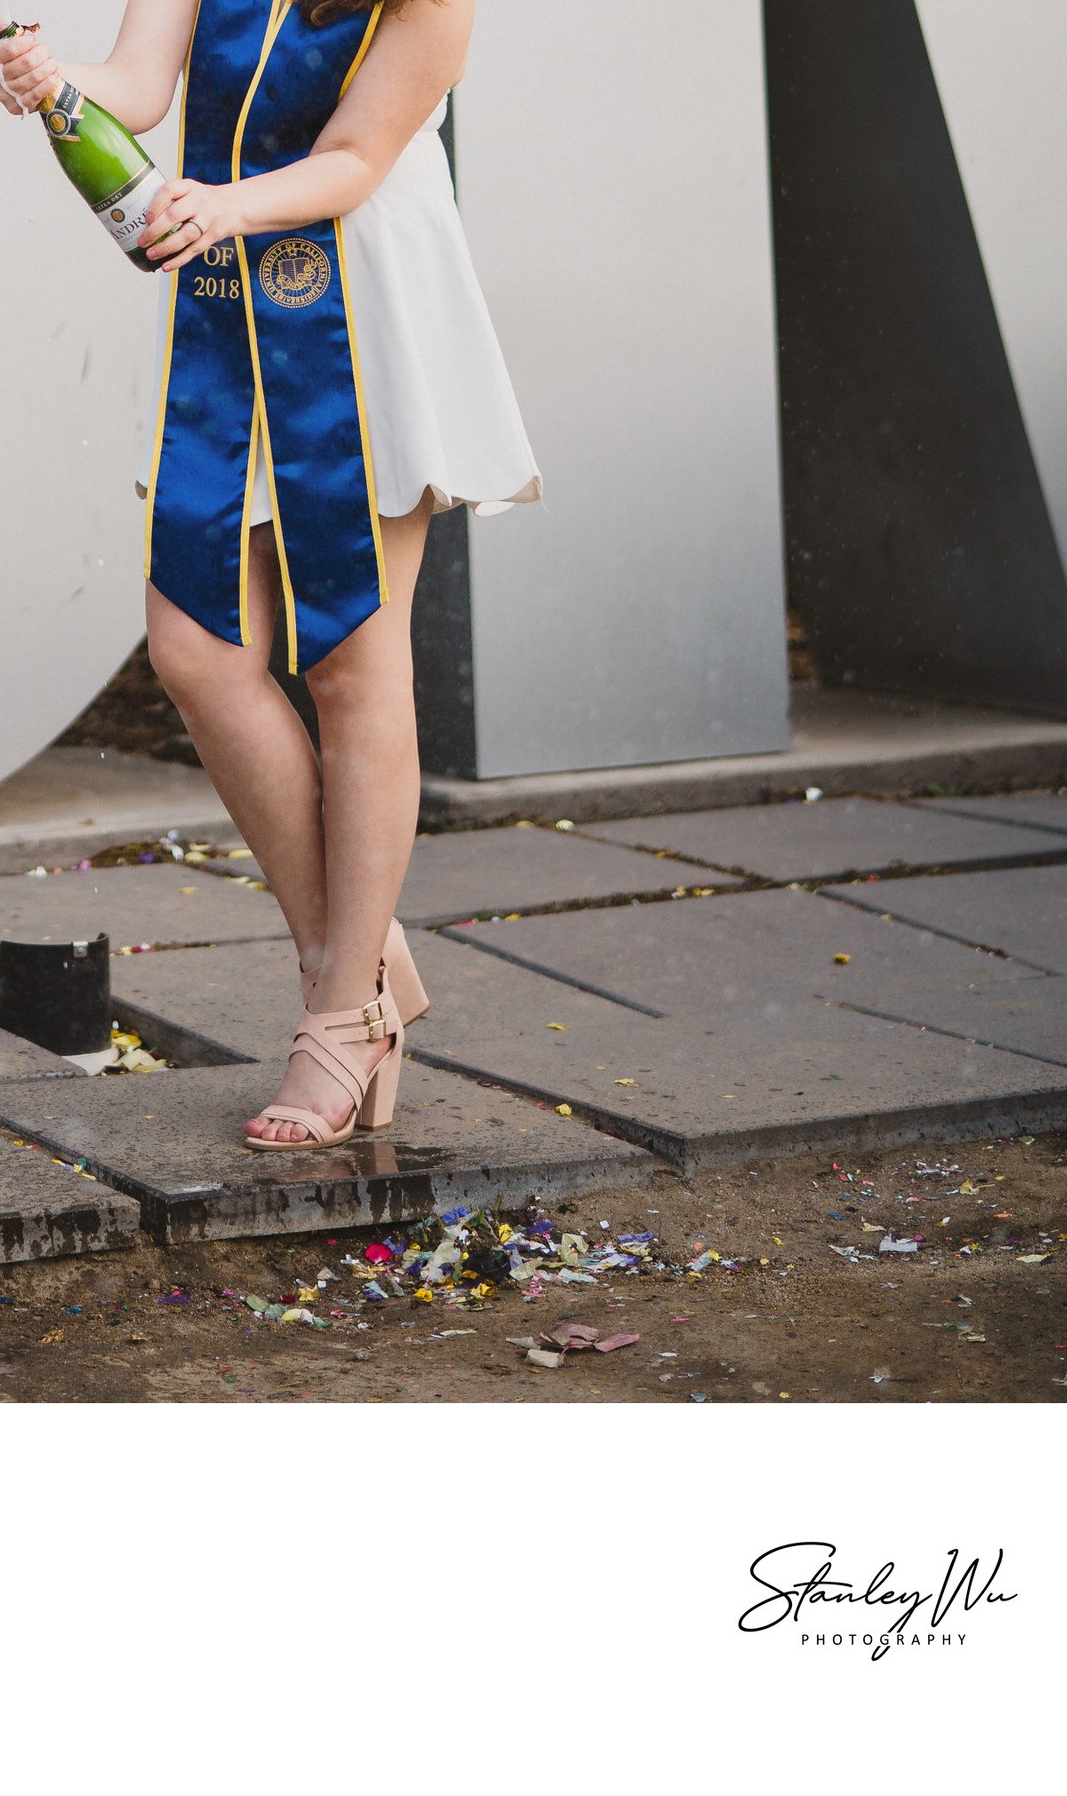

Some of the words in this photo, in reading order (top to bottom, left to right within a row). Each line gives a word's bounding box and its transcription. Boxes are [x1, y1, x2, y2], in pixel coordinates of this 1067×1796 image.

[110, 192, 123, 203] DRY
[204, 246, 234, 267] OF
[263, 246, 283, 294] UNIVERSITY
[285, 242, 297, 250] OF
[300, 243, 327, 289] CALIFORNIA
[194, 276, 240, 299] 2018
